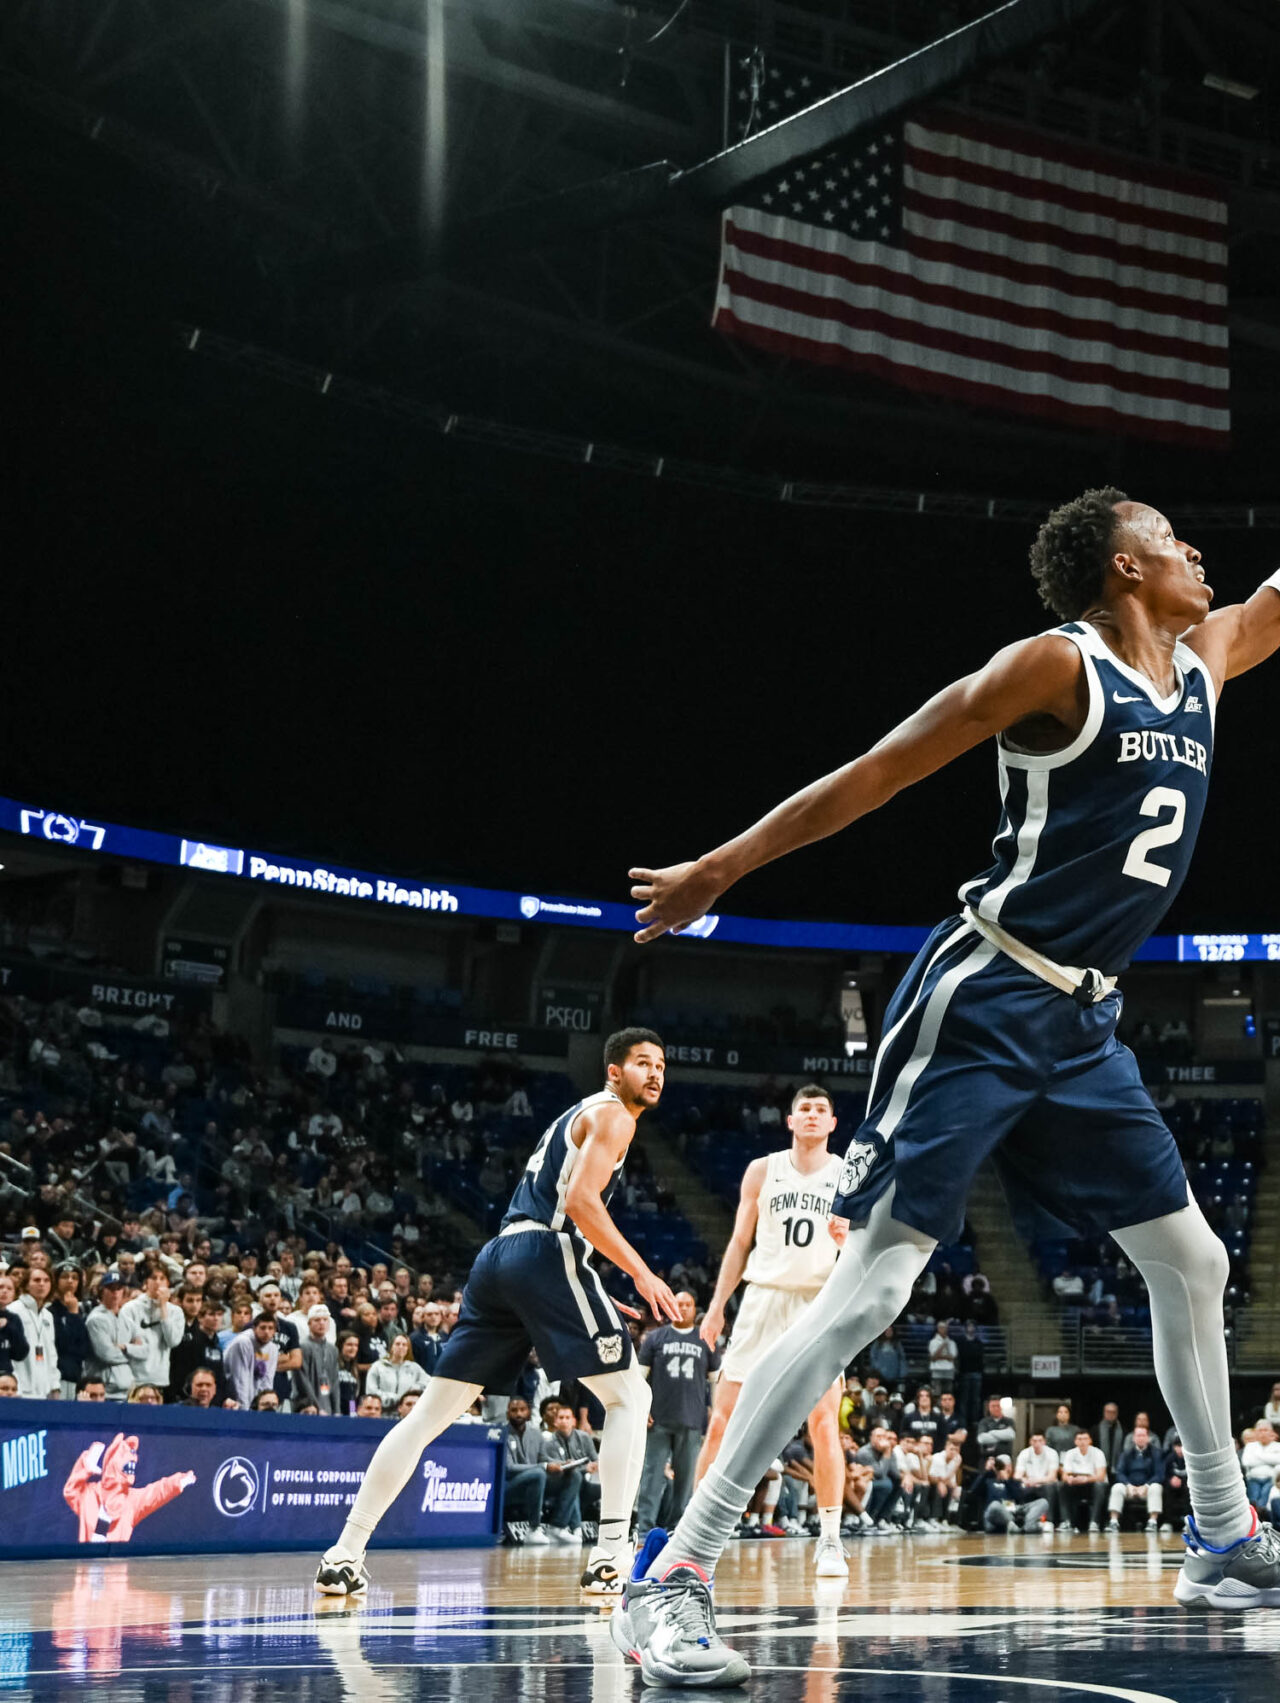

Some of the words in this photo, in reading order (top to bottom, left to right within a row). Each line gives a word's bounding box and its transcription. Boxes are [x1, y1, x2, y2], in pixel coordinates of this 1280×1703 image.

[1117, 730, 1206, 777] BUTLER
[1121, 785, 1187, 888] 2
[376, 879, 459, 912] Health
[91, 984, 175, 1011] BRIGHT
[325, 1011, 363, 1030] AND
[545, 1005, 592, 1031] PSECU
[464, 1029, 519, 1049] FREE
[1166, 1066, 1216, 1081] THEE
[770, 1192, 798, 1216] PENN
[782, 1216, 815, 1248] 10
[662, 1341, 702, 1358] PROJECT
[667, 1356, 695, 1379] 44
[1034, 1360, 1058, 1372] EXIT
[2, 1429, 49, 1490] MORE
[273, 1469, 314, 1483] OFFICIAL
[271, 1492, 285, 1506] OF
[286, 1492, 312, 1506] PENN
[421, 1477, 492, 1512] Alexander
